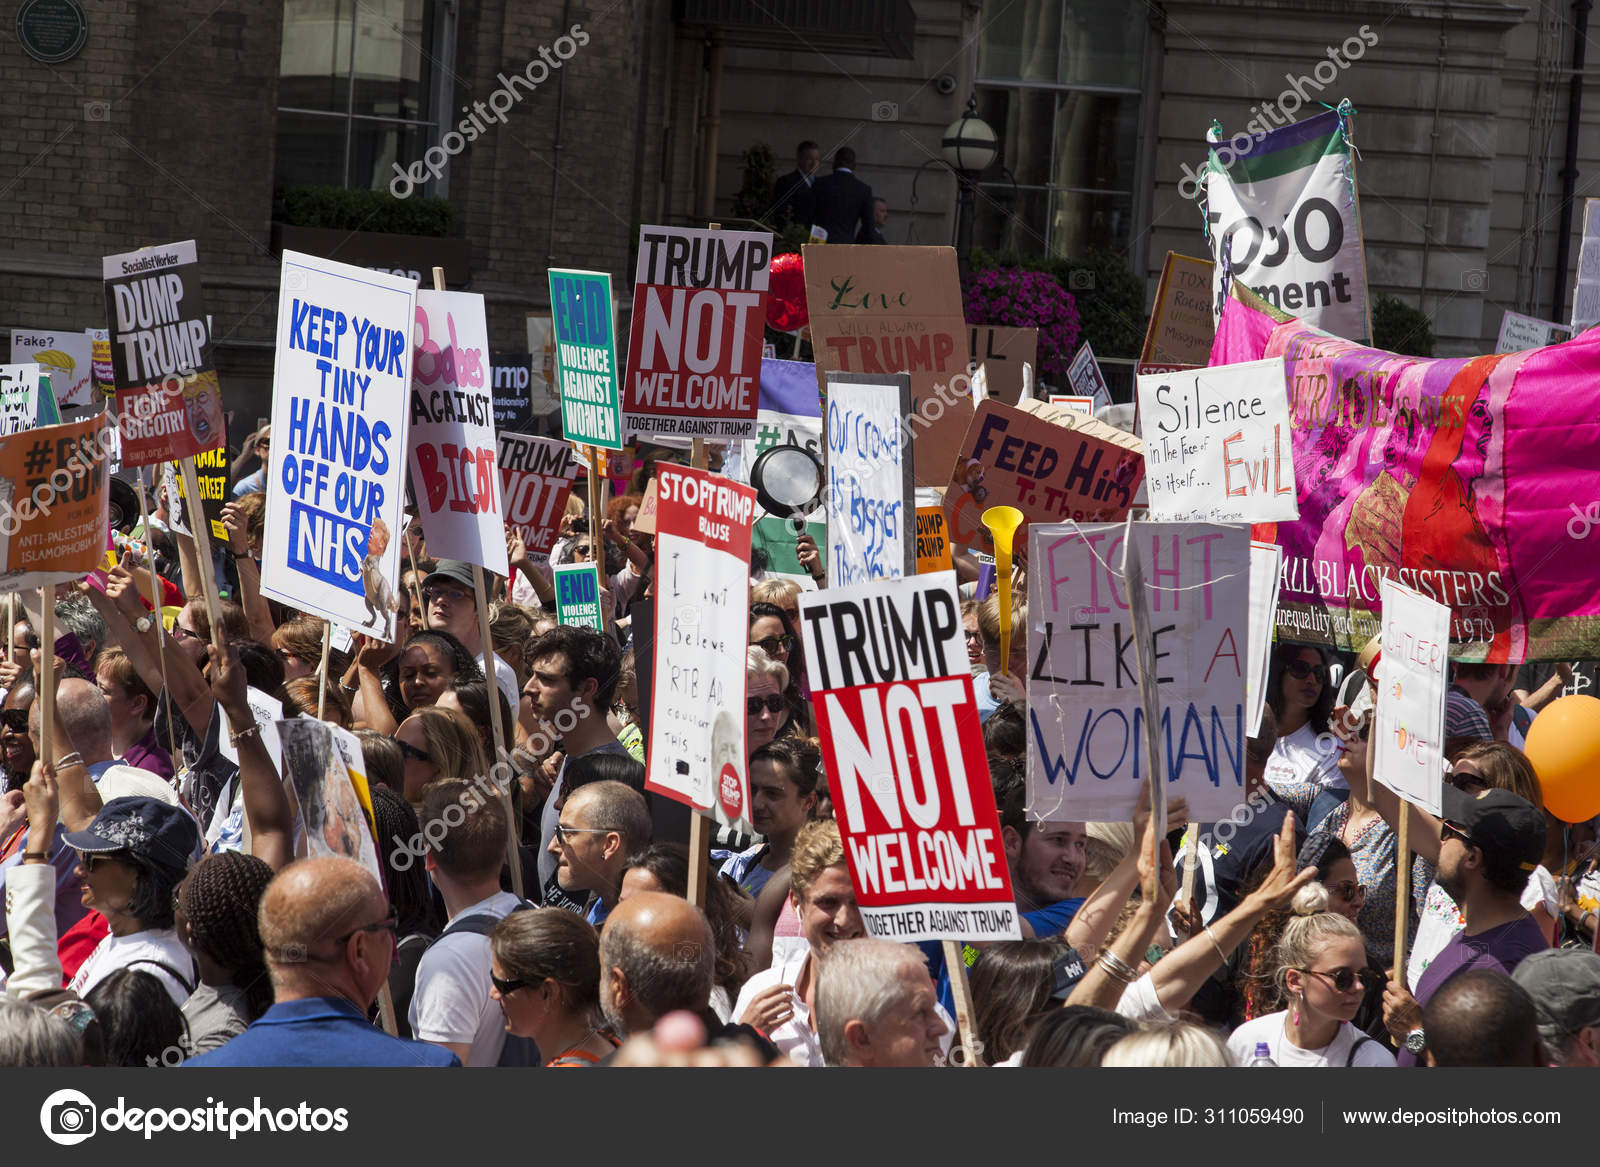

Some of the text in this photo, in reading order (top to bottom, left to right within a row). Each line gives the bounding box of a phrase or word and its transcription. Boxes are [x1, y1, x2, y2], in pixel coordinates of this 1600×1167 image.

[644, 233, 768, 290] TRUMP
[113, 273, 184, 333] DUMP
[554, 277, 608, 346] END
[828, 275, 912, 311] Love
[15, 335, 55, 348] Fake?
[116, 319, 207, 382] TRUMP
[289, 298, 404, 379] KEEP YOUR
[639, 286, 760, 376] NOT
[826, 333, 954, 374] TRUMP
[560, 342, 610, 374] VIOLENCE
[123, 390, 167, 418] FIGHT
[316, 359, 371, 411] TINY
[563, 371, 611, 405] AGAINST
[635, 370, 753, 412] WELCOME
[1156, 376, 1266, 433] Silence
[125, 409, 186, 441] BIGOTRY
[411, 390, 490, 428] AGAINST
[565, 400, 617, 442] WOMEN
[626, 415, 752, 437] TOGETHER AGAINST TRUMP
[828, 400, 852, 455] Our
[288, 396, 392, 476] HANDS
[499, 437, 577, 479] TRUMP
[971, 412, 1058, 480] FEED
[1064, 440, 1131, 508] Him
[282, 453, 385, 526] OFF OUR
[499, 474, 570, 528] NOT
[660, 471, 752, 527] STOP TRUMP
[1016, 476, 1036, 507] To
[1151, 477, 1162, 493] is
[297, 510, 364, 583] NHS
[916, 513, 943, 535] DUMP
[916, 536, 944, 559] RUMP
[559, 572, 596, 604] END
[1047, 533, 1224, 620] FIGHT
[1279, 555, 1315, 594] ALL
[1319, 559, 1391, 602] BLACK
[562, 603, 597, 617] VIOLENCE
[1276, 600, 1331, 637] inequality
[1453, 617, 1495, 645] 1979
[803, 588, 957, 690] TRUMP
[1031, 622, 1241, 689] LIKE A
[824, 679, 976, 834] NOT
[1030, 702, 1243, 788] WOMAN
[848, 828, 1004, 895] WELCOME
[864, 909, 1013, 937] TOGETHER AGAINST TRUMP
